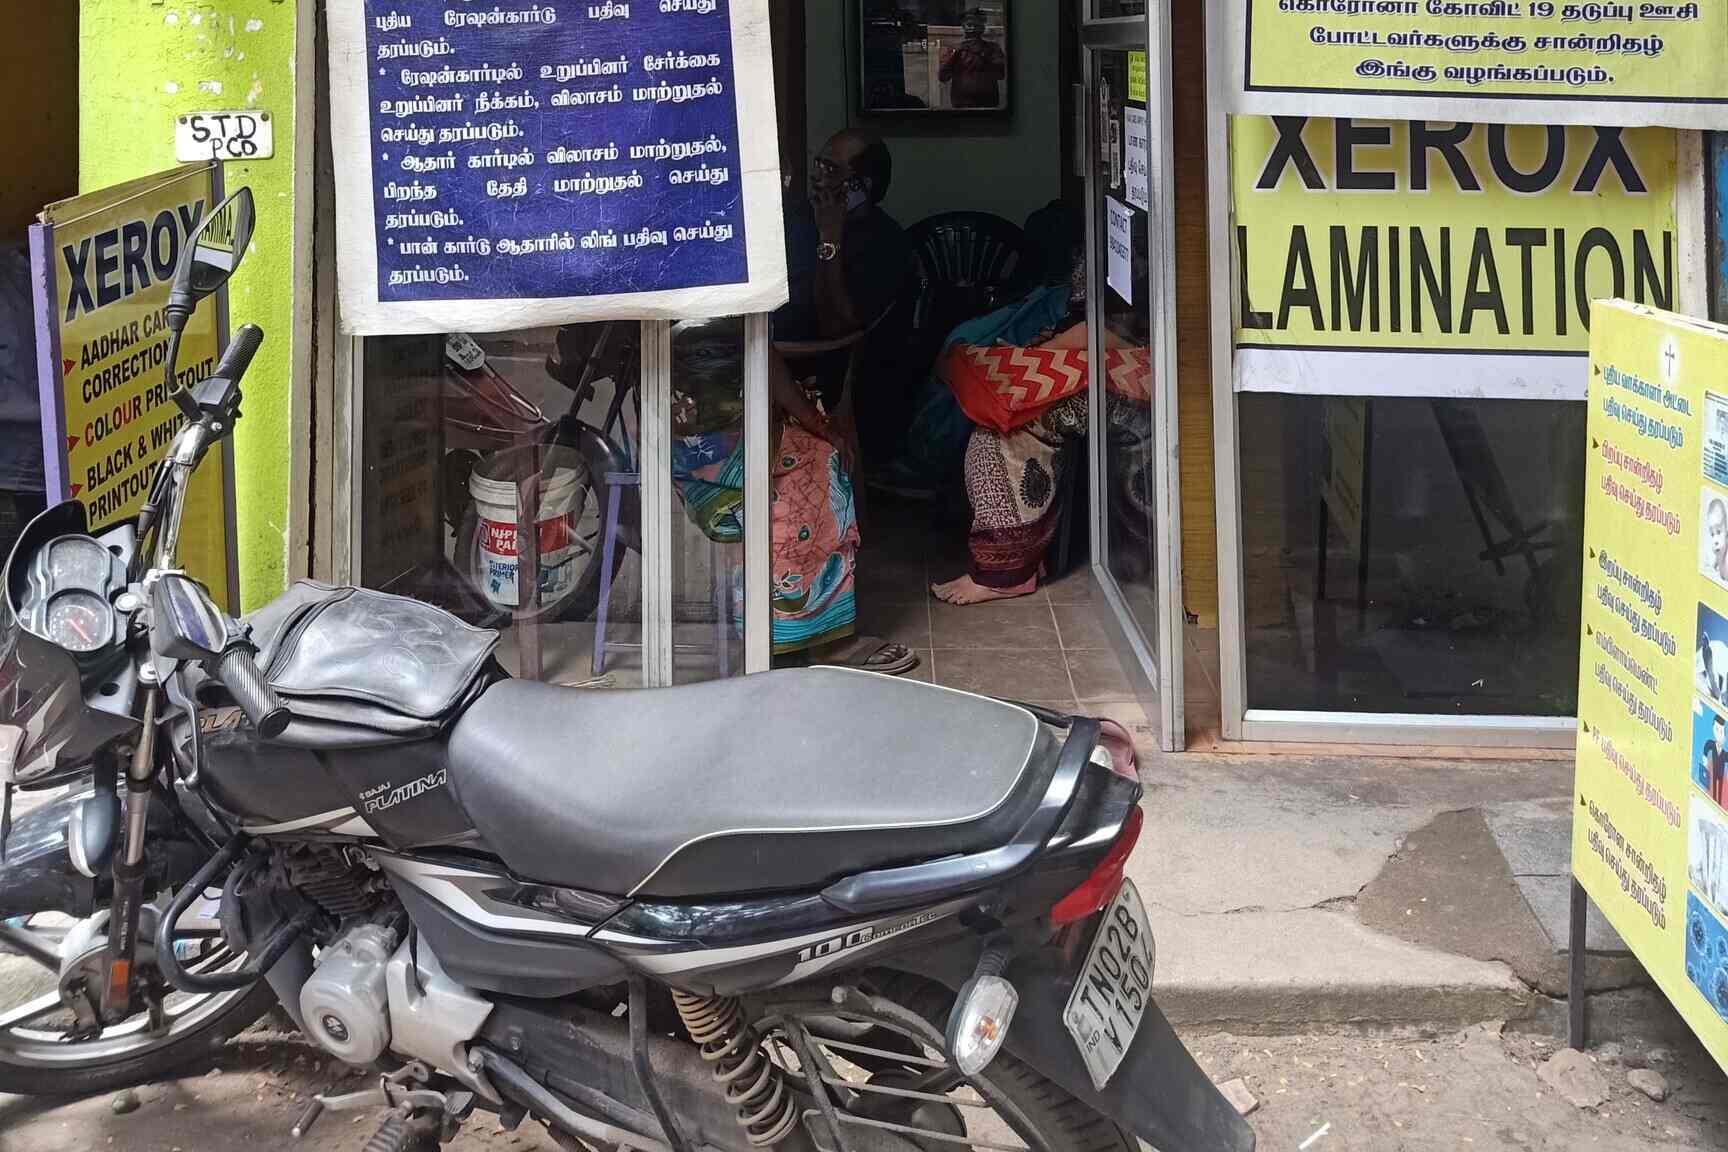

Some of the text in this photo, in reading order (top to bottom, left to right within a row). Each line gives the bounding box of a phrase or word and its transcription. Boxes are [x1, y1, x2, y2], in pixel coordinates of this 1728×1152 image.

[375, 10, 412, 32] புதிய
[443, 4, 557, 28] ரேஷன்கார்டு
[588, 0, 630, 22] பதிவு
[1528, 1, 1555, 18] 19
[1561, 0, 1634, 23] தடுப்பு
[1638, 2, 1700, 22] ஊசி
[1308, 27, 1664, 56] போட்டவர்களுக்கு சான்றிதழ்
[400, 50, 721, 88] ரேஷன்கார்டில் உறுப்பினர் சேர்க்கை
[1355, 59, 1437, 83] இங்கு
[379, 93, 465, 118] உறுப்பினர்
[550, 84, 623, 107] விலாசம்
[632, 76, 724, 104] மாற்றுதல்
[190, 115, 257, 143] STD
[380, 122, 435, 146] செய்து
[210, 138, 258, 160] PCO
[400, 150, 457, 173] ஆதார்
[467, 147, 535, 170] கார்டில்
[546, 142, 619, 165] விலாசம்
[1255, 115, 1649, 193] XEROX
[383, 163, 729, 203] பிறந்த தேதி மாற்றுதல் செய்து
[399, 219, 733, 256] பான் கார்டு ஆதாரில் லிங் பதிவு செய்து
[1236, 224, 1673, 337] LAMINATION
[80, 306, 170, 371] AADHAR CAR
[84, 356, 214, 448] COLOUR PRITOUT
[87, 413, 183, 493] BLACK & WHIT
[364, 768, 447, 814] PLATINA
[798, 926, 874, 963] 100
[1080, 904, 1139, 1021] TN02B
[1086, 1030, 1102, 1054] IND
